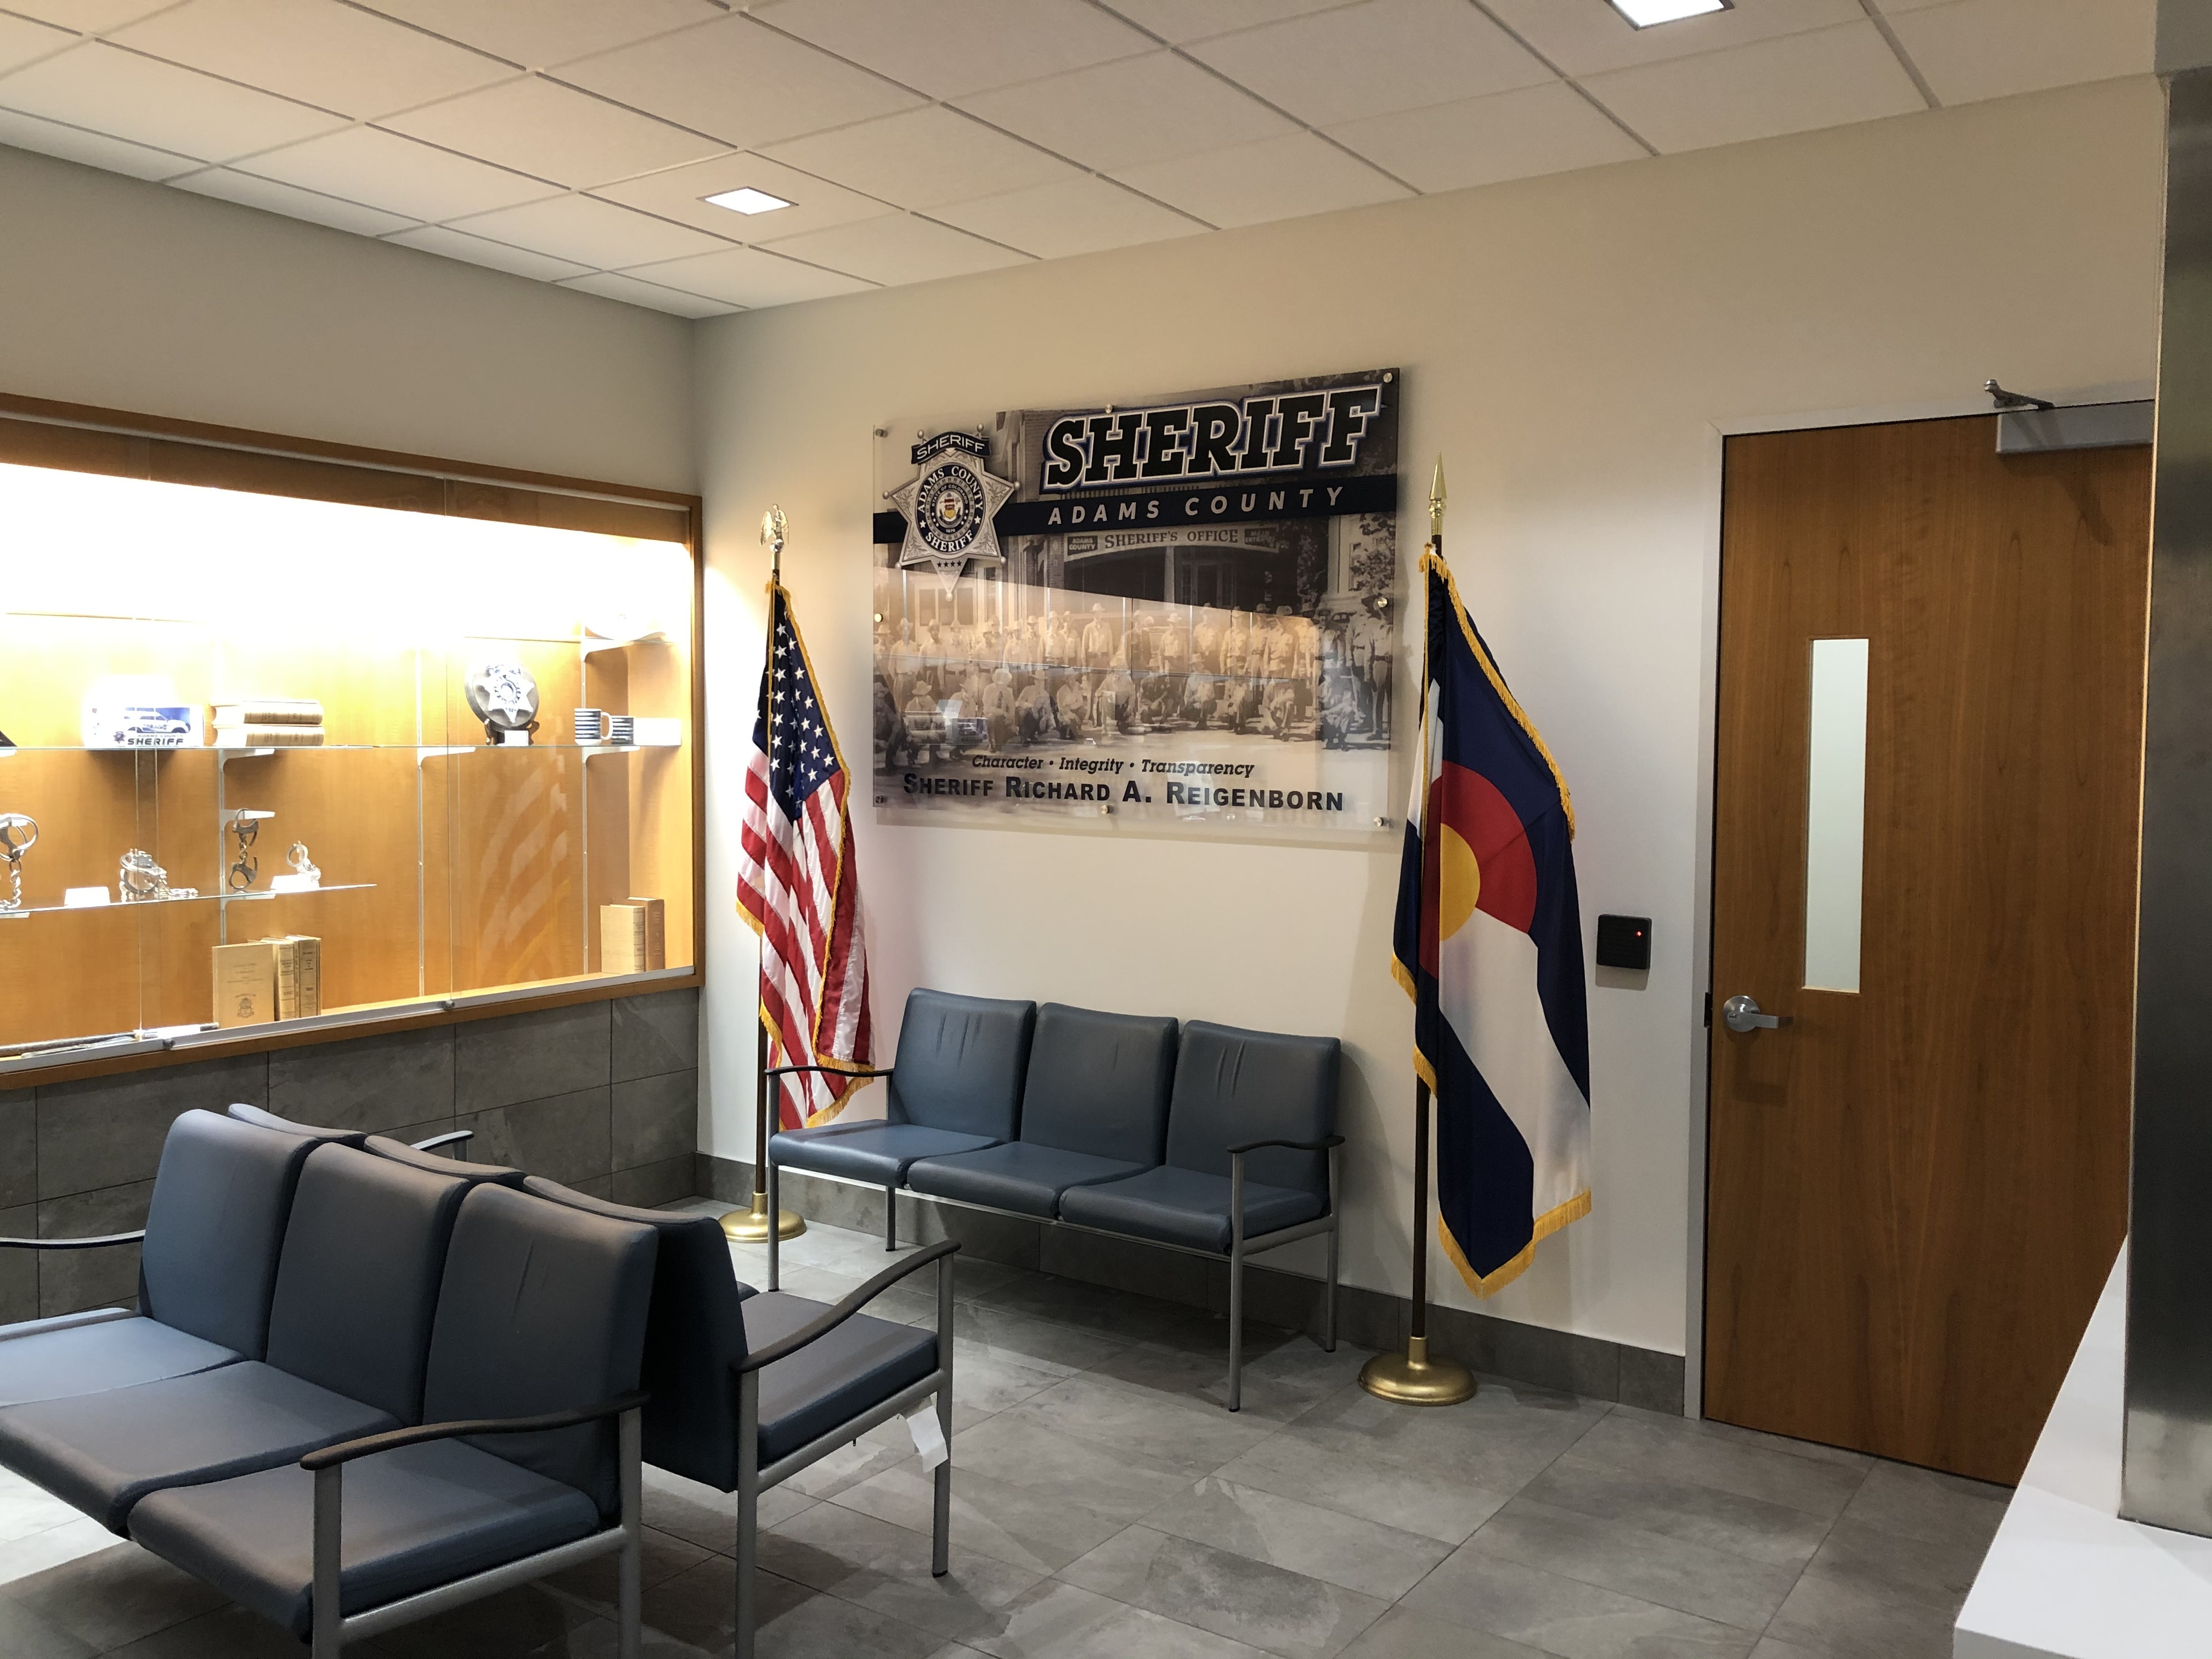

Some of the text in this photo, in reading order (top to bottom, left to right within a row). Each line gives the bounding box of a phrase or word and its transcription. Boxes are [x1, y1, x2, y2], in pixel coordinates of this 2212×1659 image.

[917, 435, 985, 460] SHERIFF
[1042, 385, 1382, 490] SHERIFF
[917, 466, 983, 514] ADAMS COUNTY
[948, 484, 968, 504] COLORADO
[1047, 486, 1344, 525] ADAMS COUNTY
[925, 529, 973, 552] SHERIFF
[1104, 529, 1238, 549] SHERIFF'S OFFICE
[972, 754, 1256, 778] Character Integrity Transparency
[903, 772, 1344, 811] SHERIFF RICHARD A. REIGENBORN
